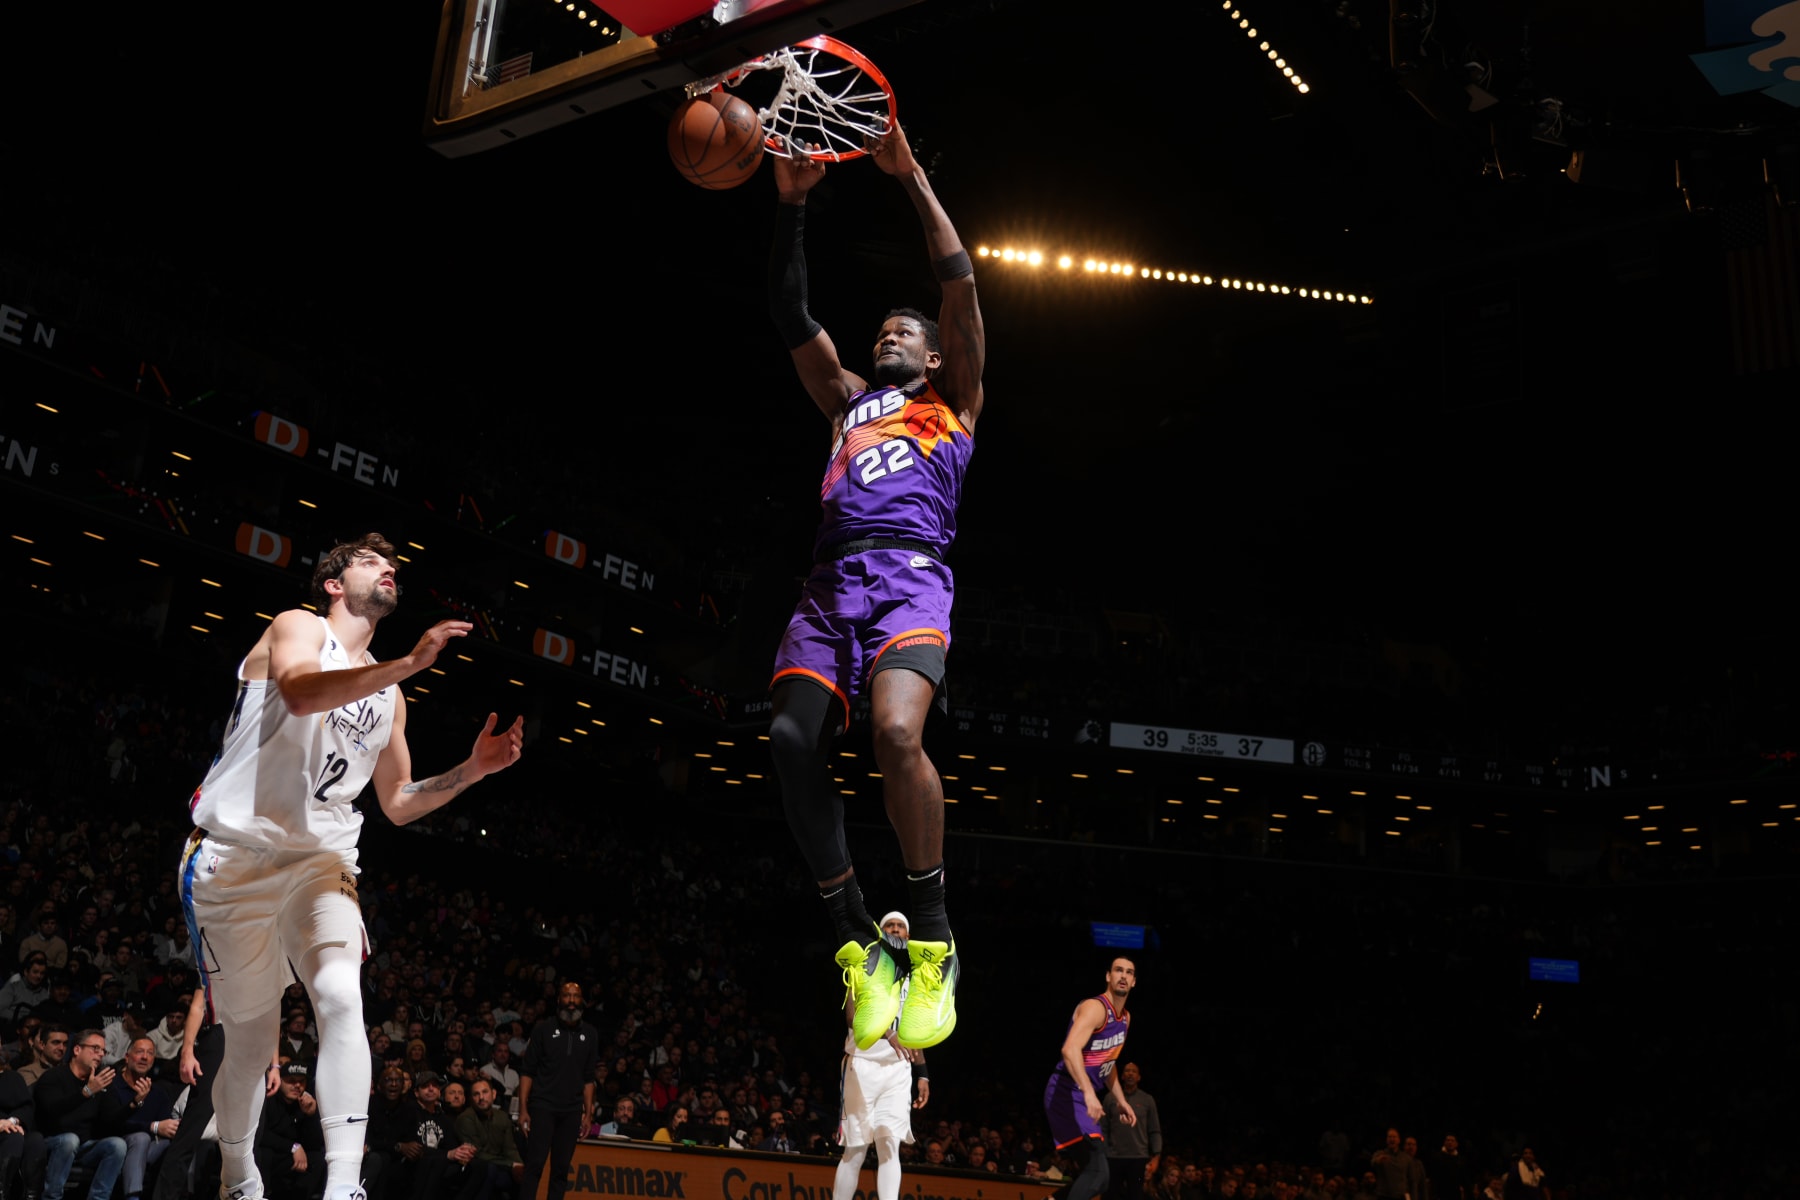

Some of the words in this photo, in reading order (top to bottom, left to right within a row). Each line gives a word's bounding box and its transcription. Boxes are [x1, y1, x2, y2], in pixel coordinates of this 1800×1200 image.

[855, 439, 914, 486] 22
[325, 710, 365, 745] NETS
[1143, 728, 1169, 749] 39
[1187, 732, 1218, 748] 5:35
[1237, 738, 1264, 758] 37
[1180, 745, 1195, 753] 2nd
[1196, 746, 1225, 756] Quarter
[313, 751, 348, 803] 12
[1090, 1031, 1125, 1051] SUNS
[1099, 1060, 1116, 1078] 20
